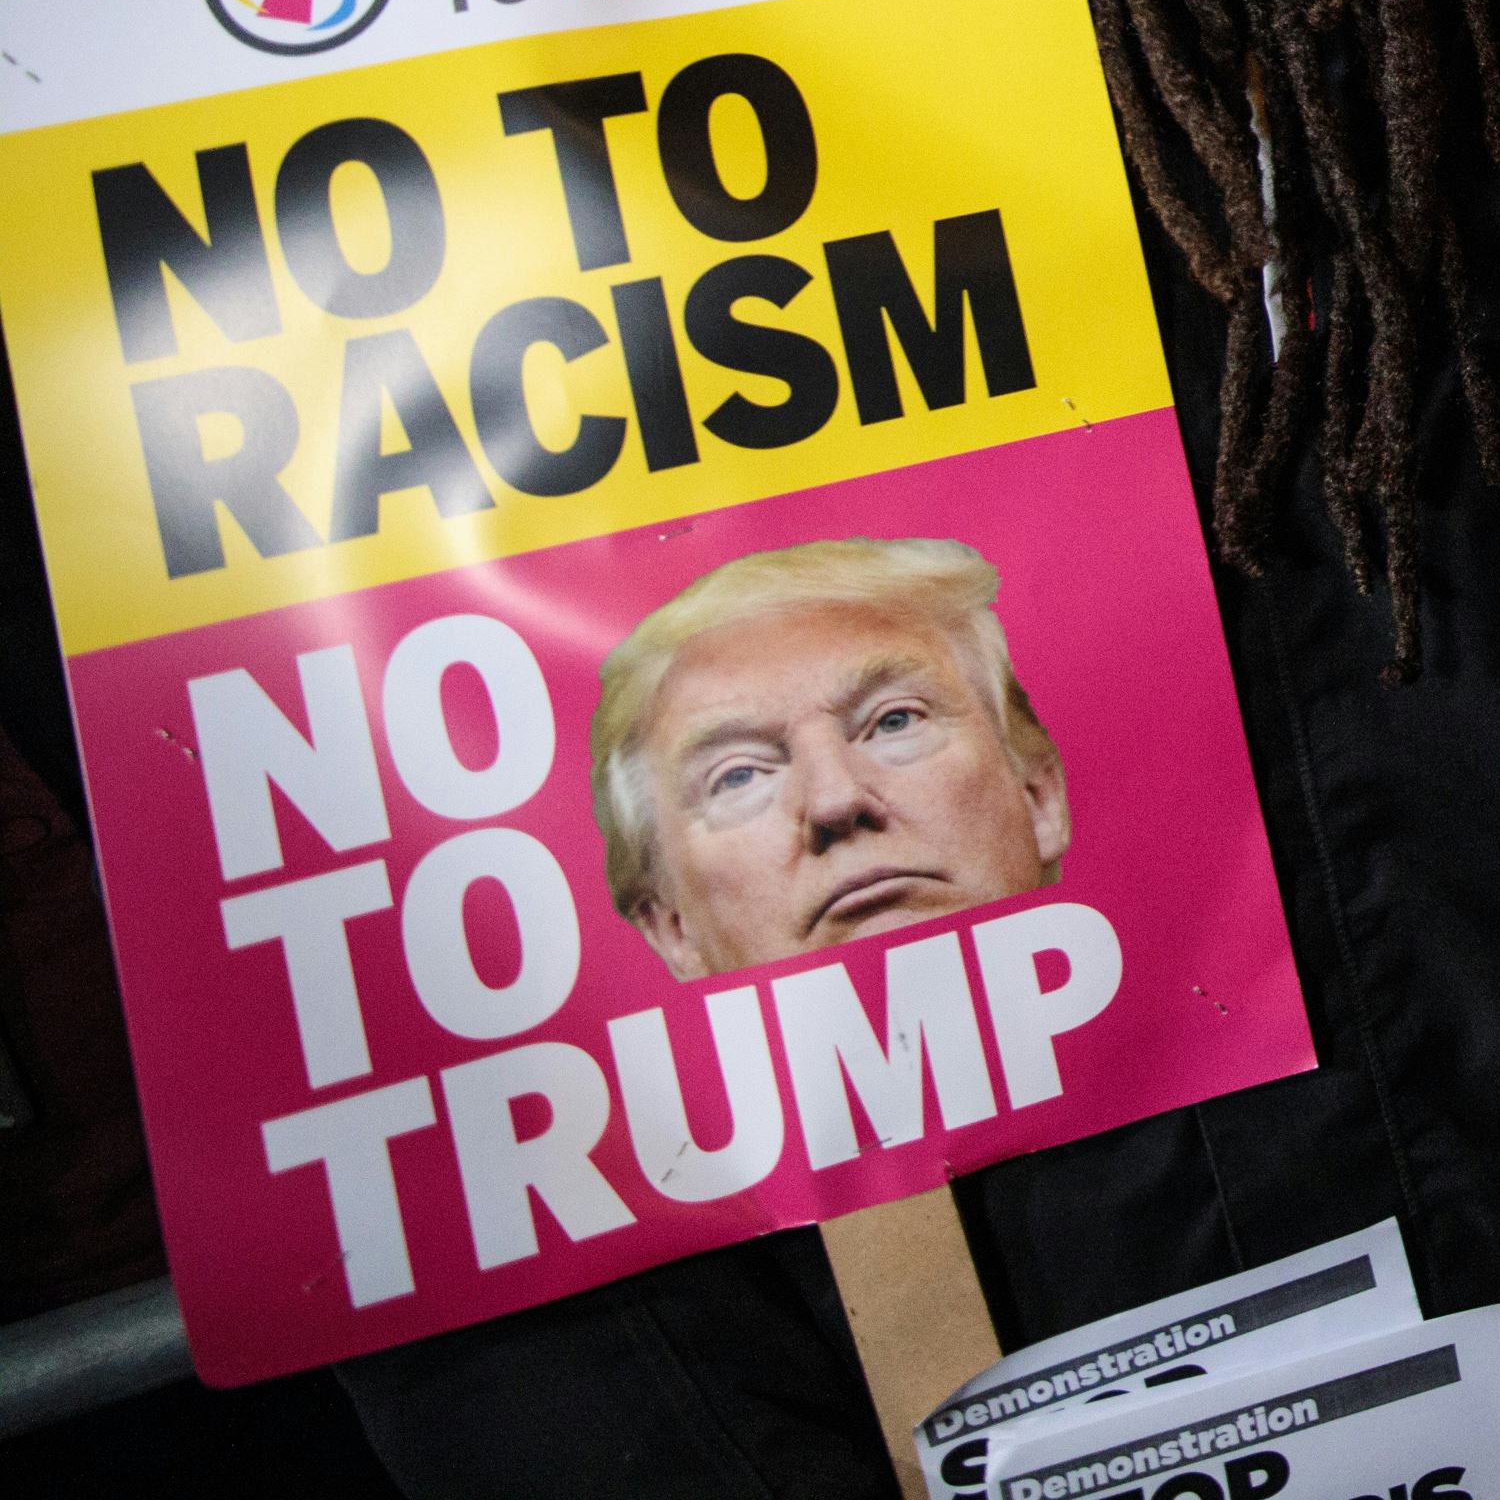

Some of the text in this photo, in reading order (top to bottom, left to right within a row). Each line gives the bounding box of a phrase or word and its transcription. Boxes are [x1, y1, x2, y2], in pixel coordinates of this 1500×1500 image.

[91, 52, 819, 366] NO TO
[130, 207, 1038, 581] RACISM
[186, 613, 557, 882] NO
[219, 826, 581, 1091] TO
[259, 901, 1124, 1310] TRUMP
[931, 1312, 1236, 1440] Demonstration
[1010, 1398, 1320, 1500] Demonstration
